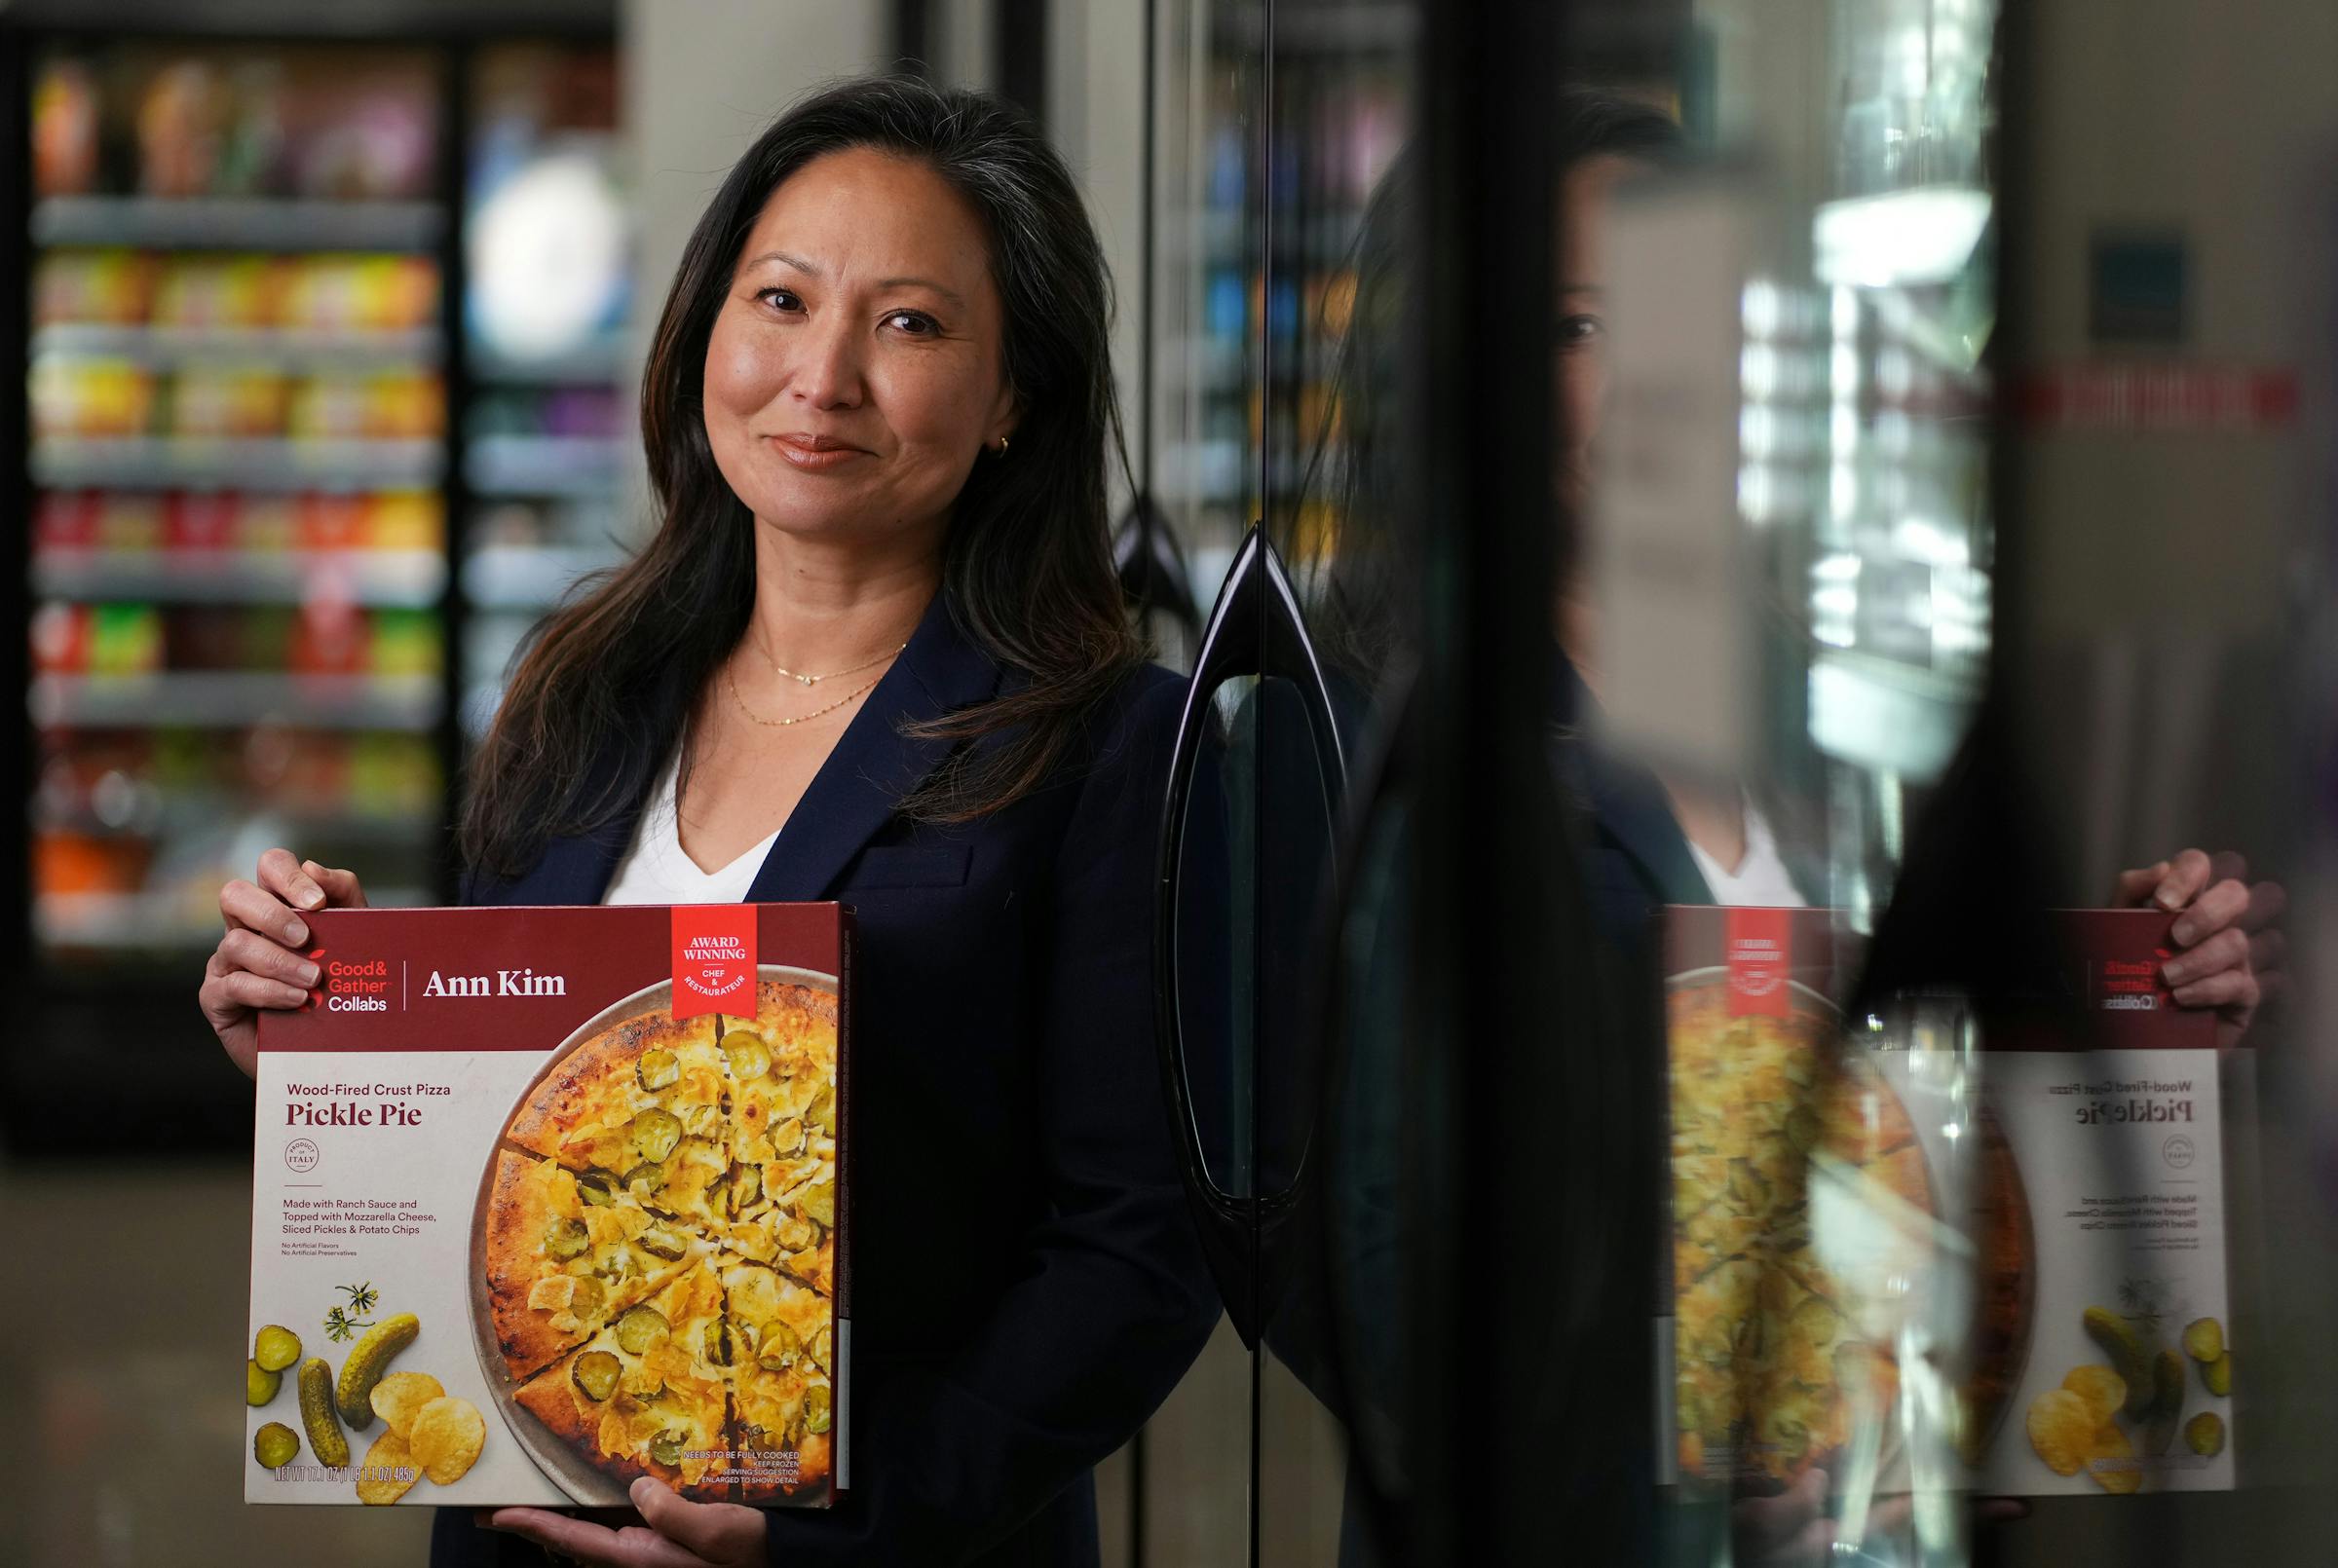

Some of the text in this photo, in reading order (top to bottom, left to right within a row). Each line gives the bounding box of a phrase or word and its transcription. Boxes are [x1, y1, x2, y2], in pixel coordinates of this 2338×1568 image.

[690, 937, 739, 948] AWARD
[684, 949, 746, 960] WINNING
[702, 969, 725, 978] CHEF
[328, 979, 387, 993] Gather
[423, 968, 566, 997] Ann Kim
[684, 975, 746, 996] RESTAURATEUR
[711, 978, 718, 987] &
[328, 995, 387, 1012] Collabs
[287, 1084, 451, 1096] Wood-Fired Crust Pizza
[285, 1101, 423, 1126] Pickle Pie
[289, 1142, 315, 1153] PRODUCT
[283, 1199, 417, 1209] Made with Ranch Sauce and
[283, 1212, 437, 1223] Topped with Mozzarella Cheese,
[282, 1224, 420, 1236] Sliced Pickles & Potato Chips
[274, 1466, 291, 1481] NET
[292, 1466, 306, 1481] WT
[307, 1466, 324, 1481] 17.1
[327, 1466, 339, 1481] OZ
[350, 1466, 360, 1481] LB
[363, 1466, 376, 1481] 1.1
[378, 1466, 392, 1482] OZ)
[394, 1466, 415, 1483] 485g
